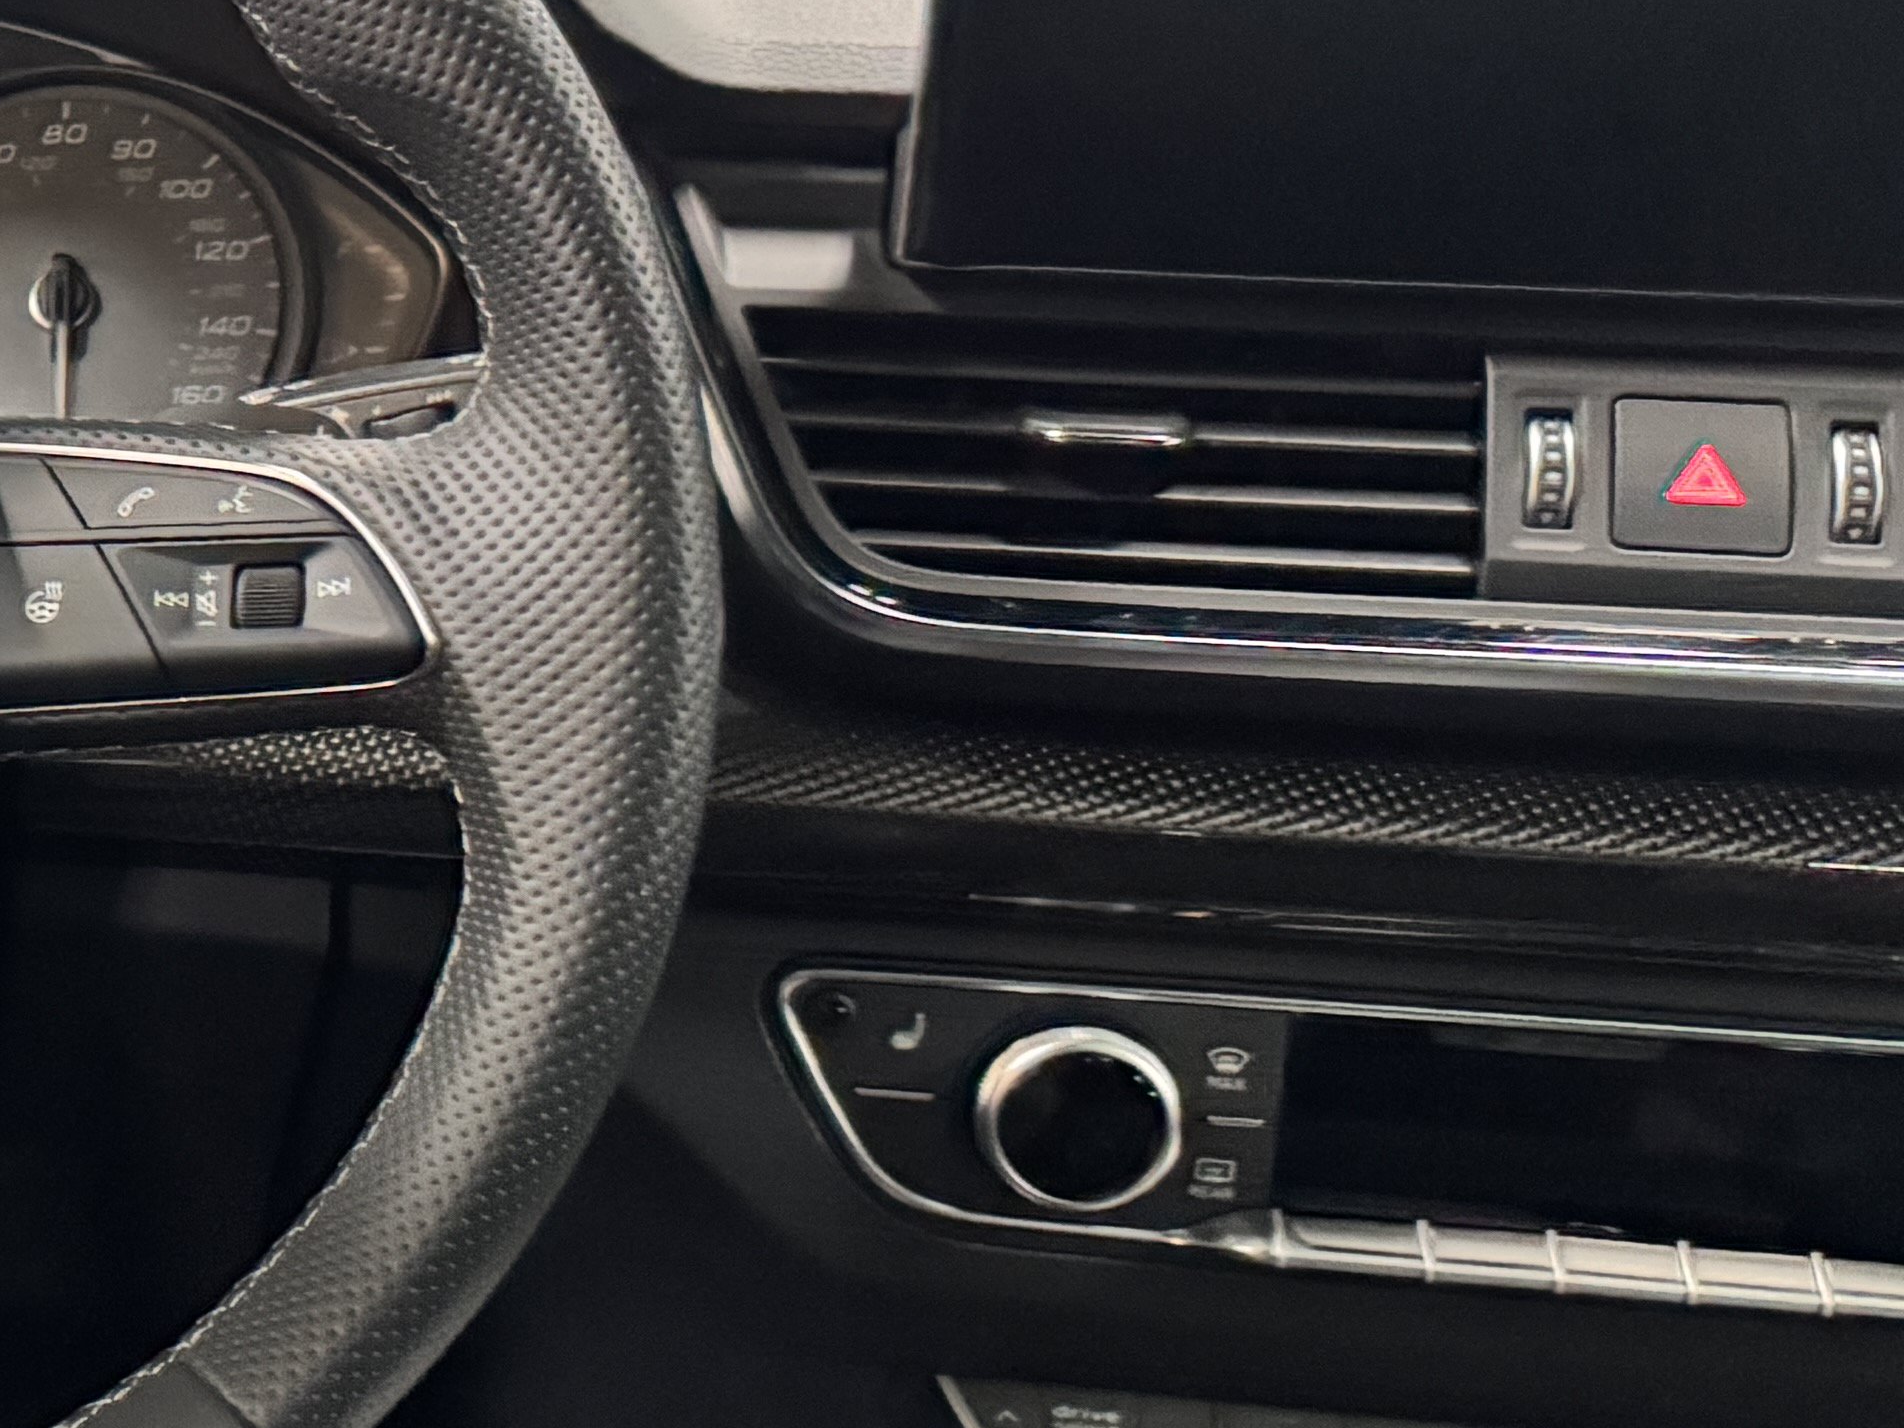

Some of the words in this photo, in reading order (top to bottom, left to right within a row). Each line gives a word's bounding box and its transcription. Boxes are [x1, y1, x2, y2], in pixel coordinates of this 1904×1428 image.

[41, 123, 88, 146] 80
[110, 138, 158, 160] 90
[158, 178, 214, 200] 100
[194, 240, 250, 262] 120
[199, 315, 254, 337] 140
[171, 386, 226, 405] 160
